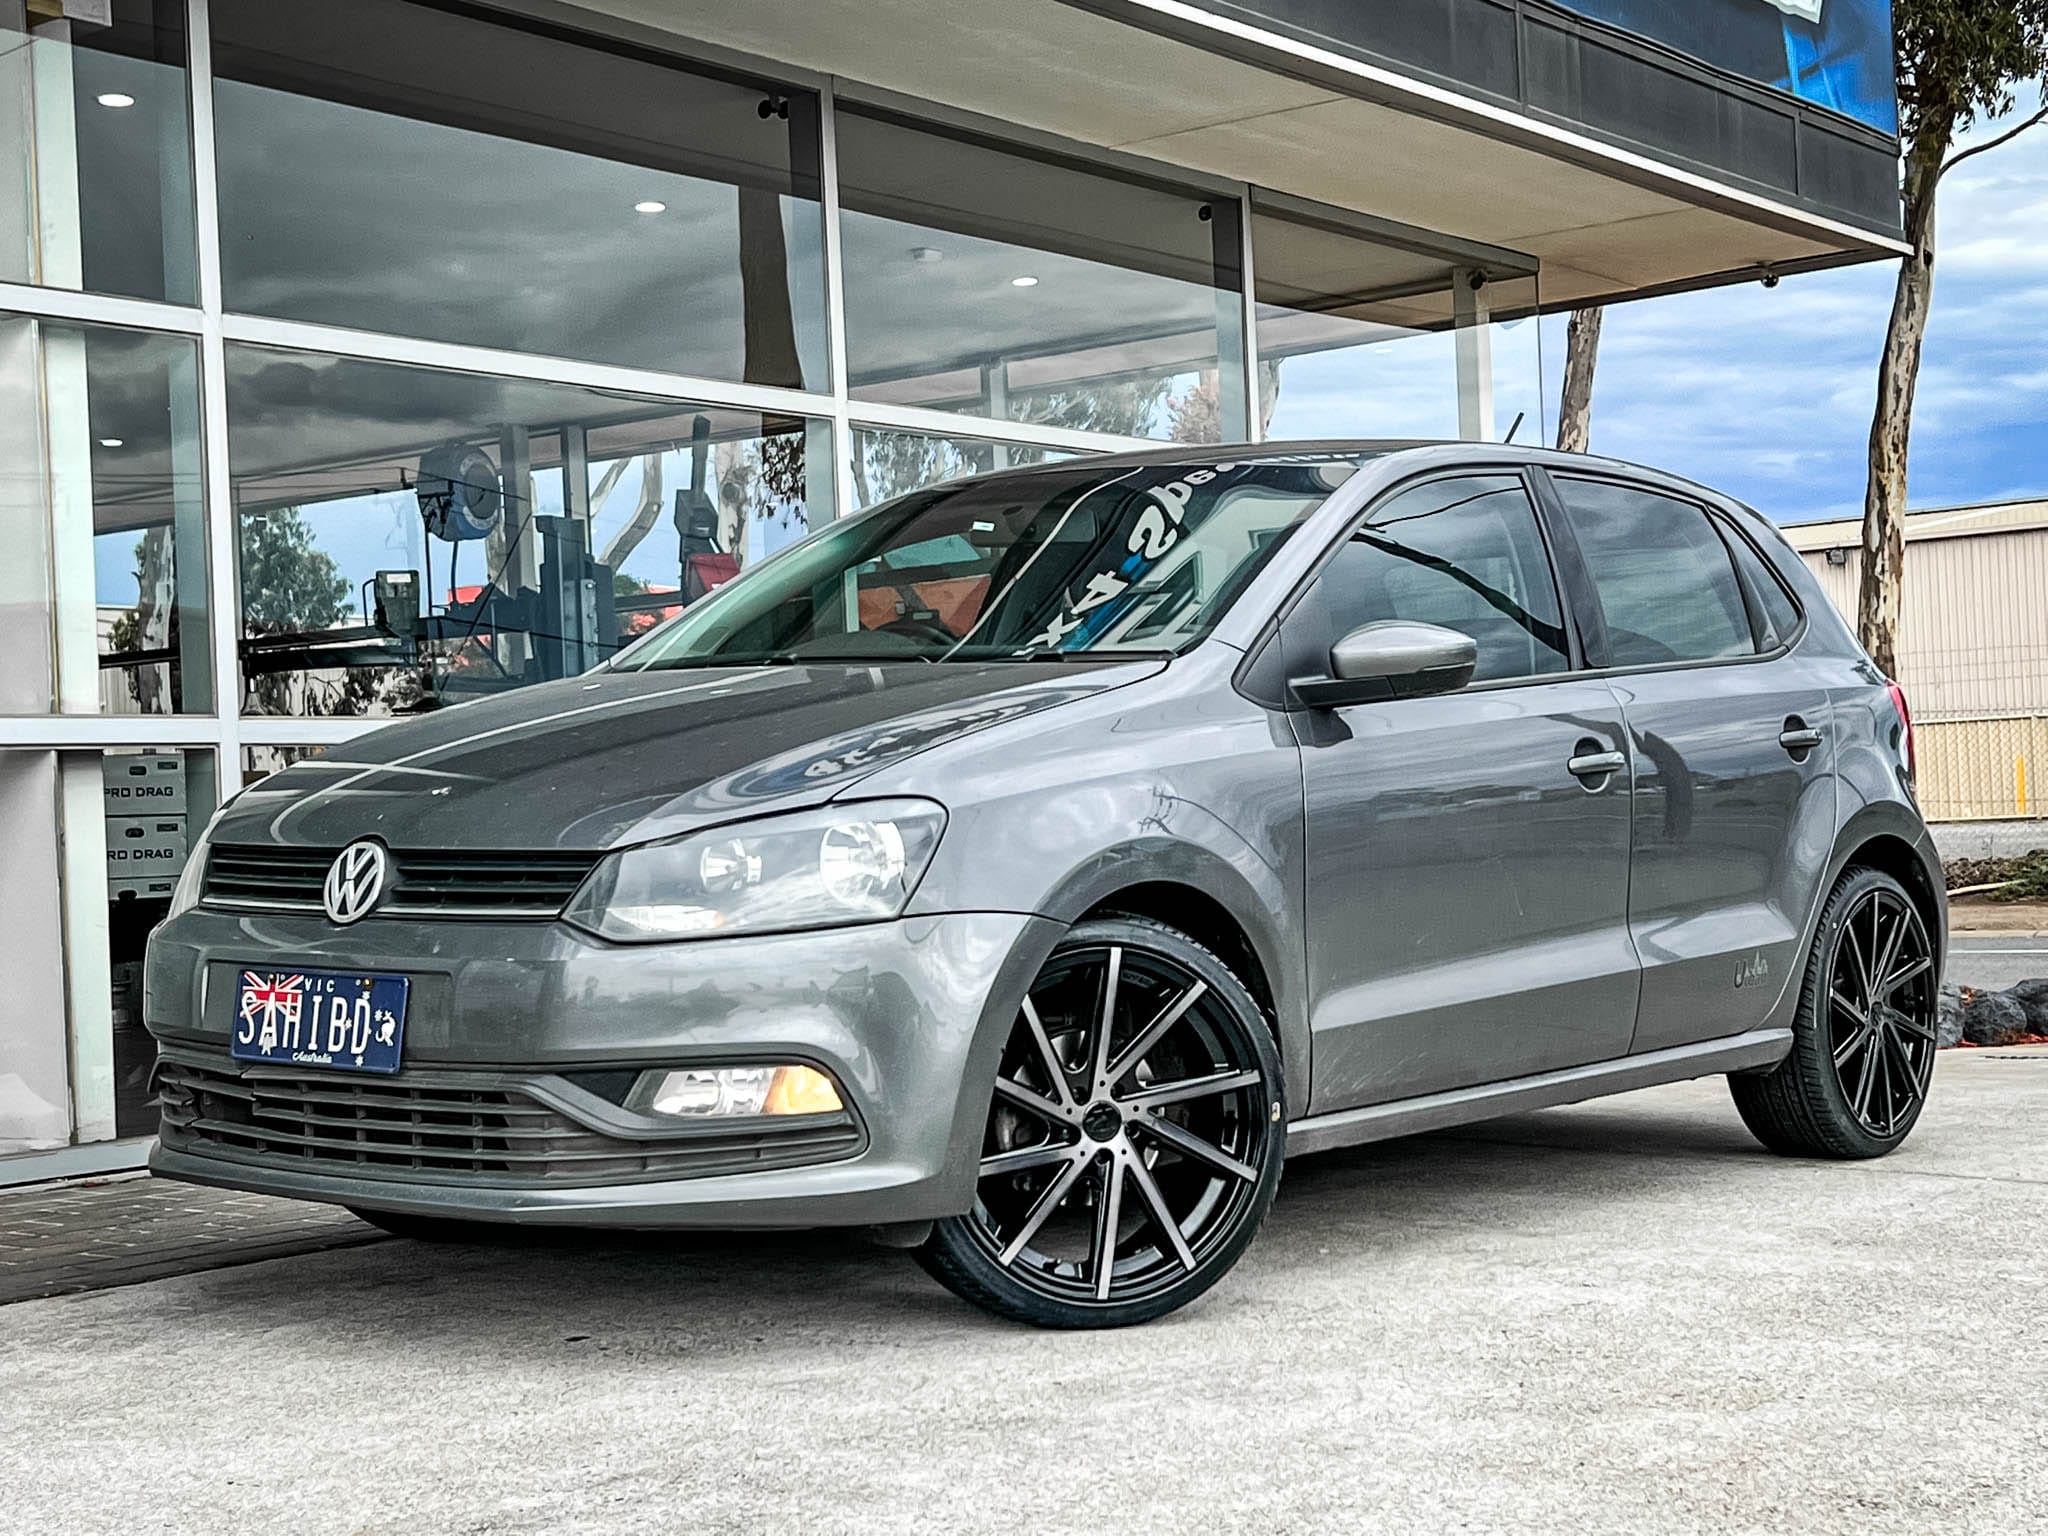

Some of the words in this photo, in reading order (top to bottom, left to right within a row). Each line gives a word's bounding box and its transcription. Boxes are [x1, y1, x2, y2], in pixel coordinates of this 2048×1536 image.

[135, 786, 174, 798] DRAG
[107, 850, 128, 860] RO
[133, 849, 174, 860] DRAG
[304, 977, 335, 992] VIC
[292, 1050, 333, 1064] Australia
